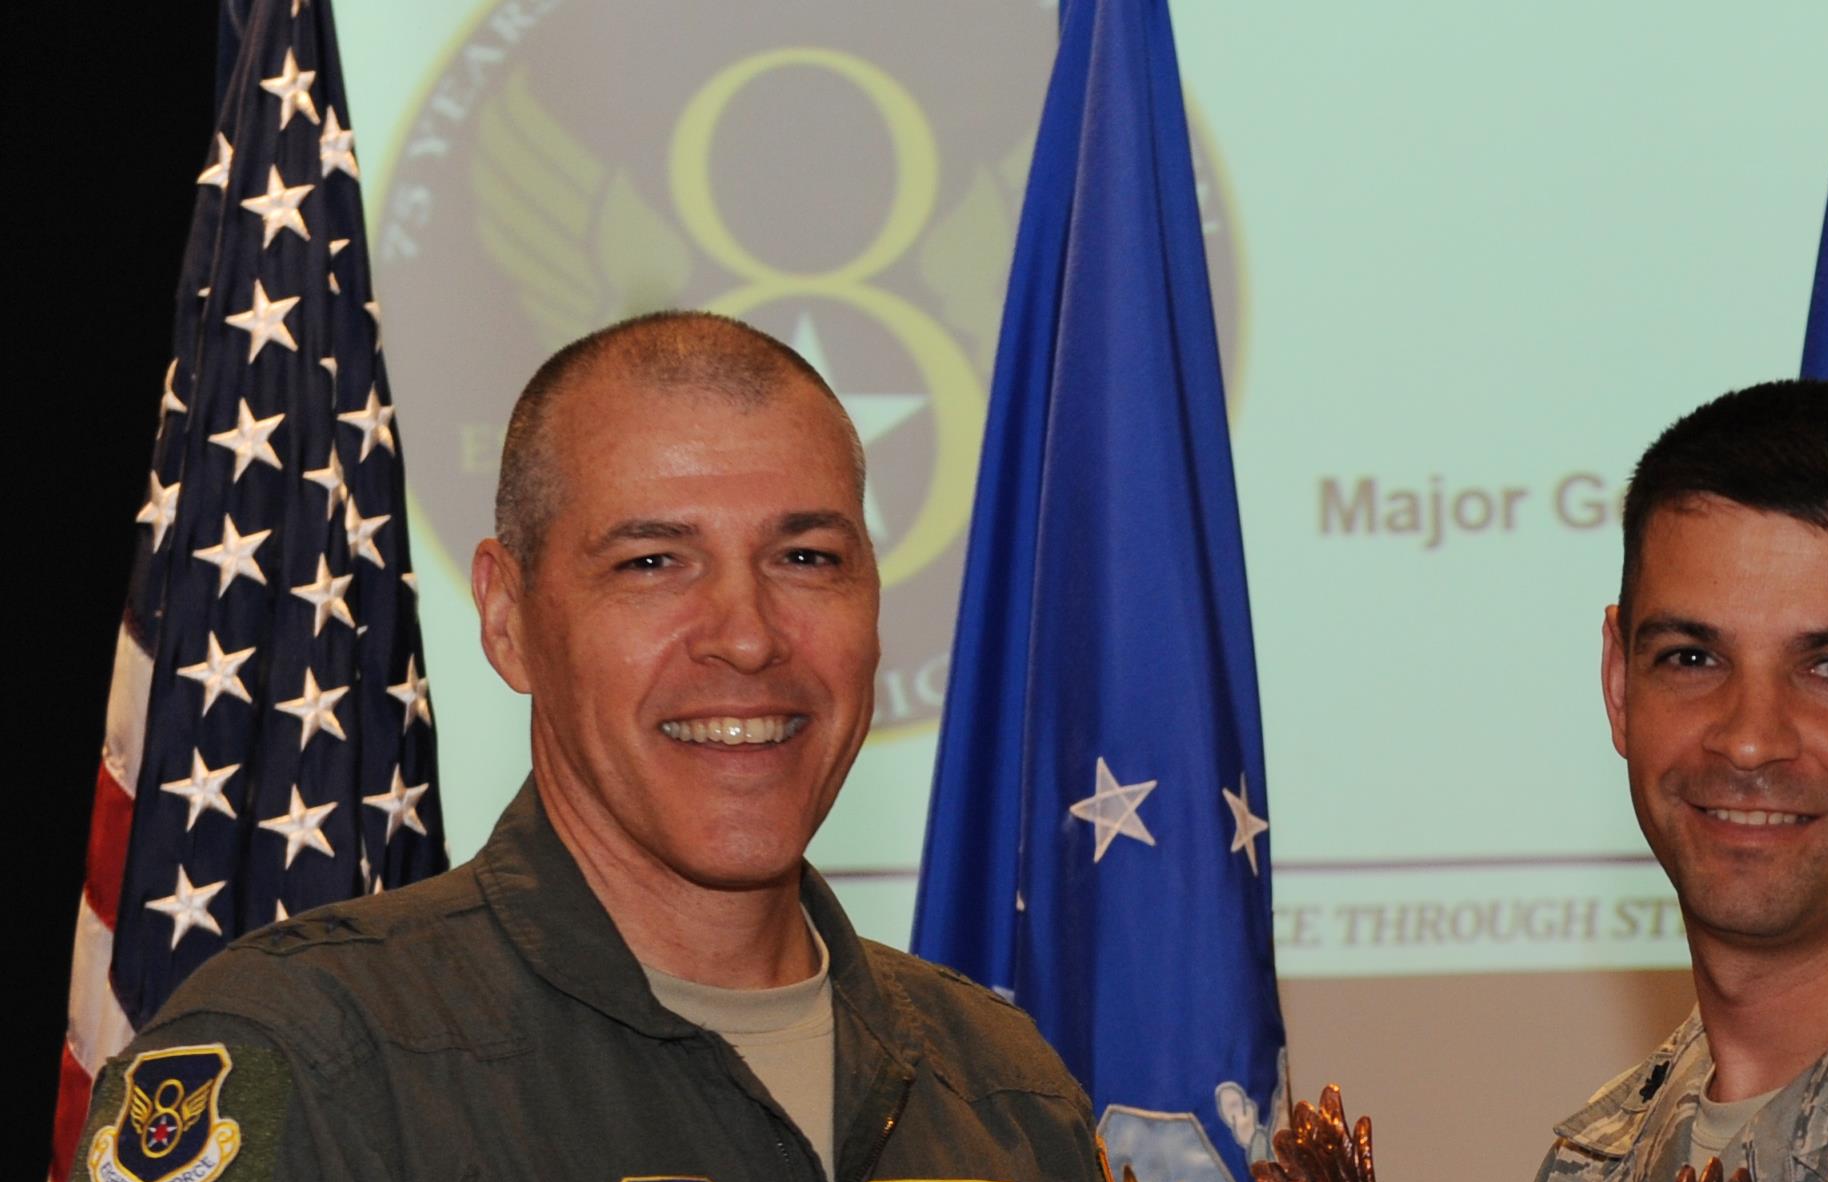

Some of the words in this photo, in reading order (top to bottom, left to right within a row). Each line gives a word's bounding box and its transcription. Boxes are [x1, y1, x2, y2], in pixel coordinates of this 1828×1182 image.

[1317, 472, 1531, 551] Major
[1553, 472, 1625, 531] G
[1332, 897, 1599, 946] THROUGH
